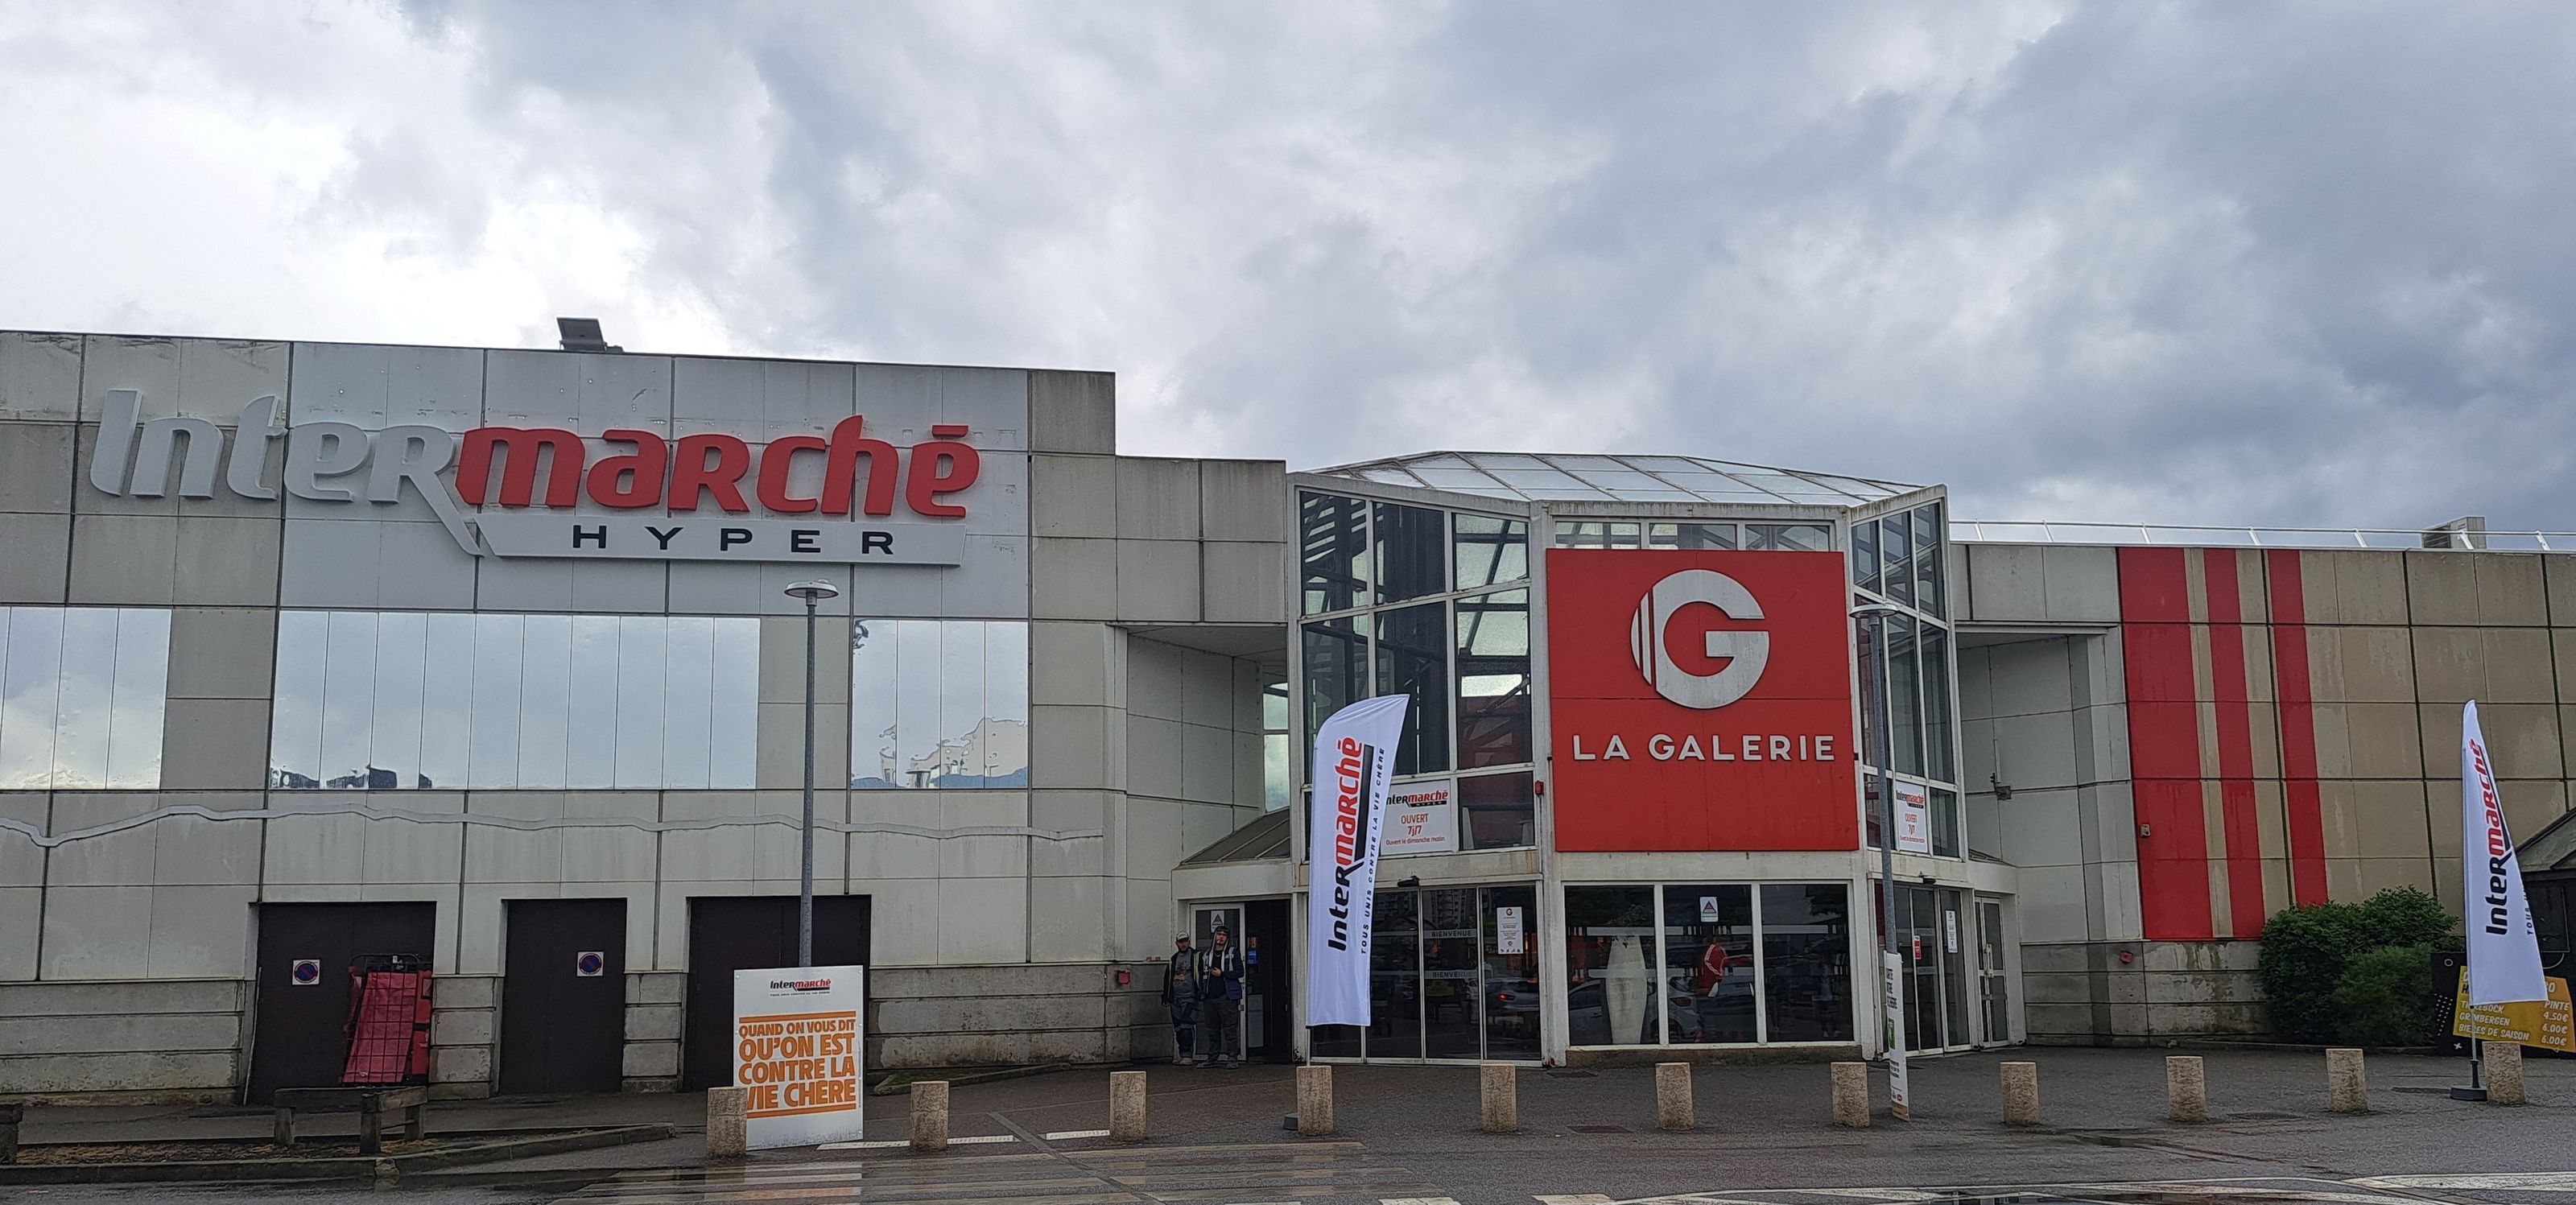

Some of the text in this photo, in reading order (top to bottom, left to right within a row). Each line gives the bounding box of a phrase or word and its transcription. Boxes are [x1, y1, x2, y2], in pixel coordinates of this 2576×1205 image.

[89, 390, 980, 557] Intermarché
[572, 525, 894, 555] HYPER
[1630, 569, 1769, 709] G
[1573, 733, 1835, 761] LA GALERIE
[1376, 748, 1385, 786] CHÈRE
[1386, 790, 1448, 807] ntermarché
[1372, 818, 1378, 830] LA
[1401, 813, 1429, 824] OUVERT
[1328, 737, 1364, 951] Intermarché
[1368, 836, 1377, 882] CONTRE
[1431, 930, 1472, 938] BIENVENUE
[770, 978, 831, 992] Intermarché
[2545, 1001, 2570, 1011] PINTE
[2459, 1011, 2569, 1025] GRMBERGEN 4.50€
[739, 1019, 857, 1038] QUAND ON VOUS DIT
[2487, 1027, 2499, 1037] DE
[2500, 1029, 2529, 1041] SAISON
[2542, 1023, 2567, 1034] 6.00€
[739, 1033, 855, 1062] QU'ON EST
[2541, 1035, 2567, 1046] 6.00€
[738, 1056, 856, 1084] CONTRE LA
